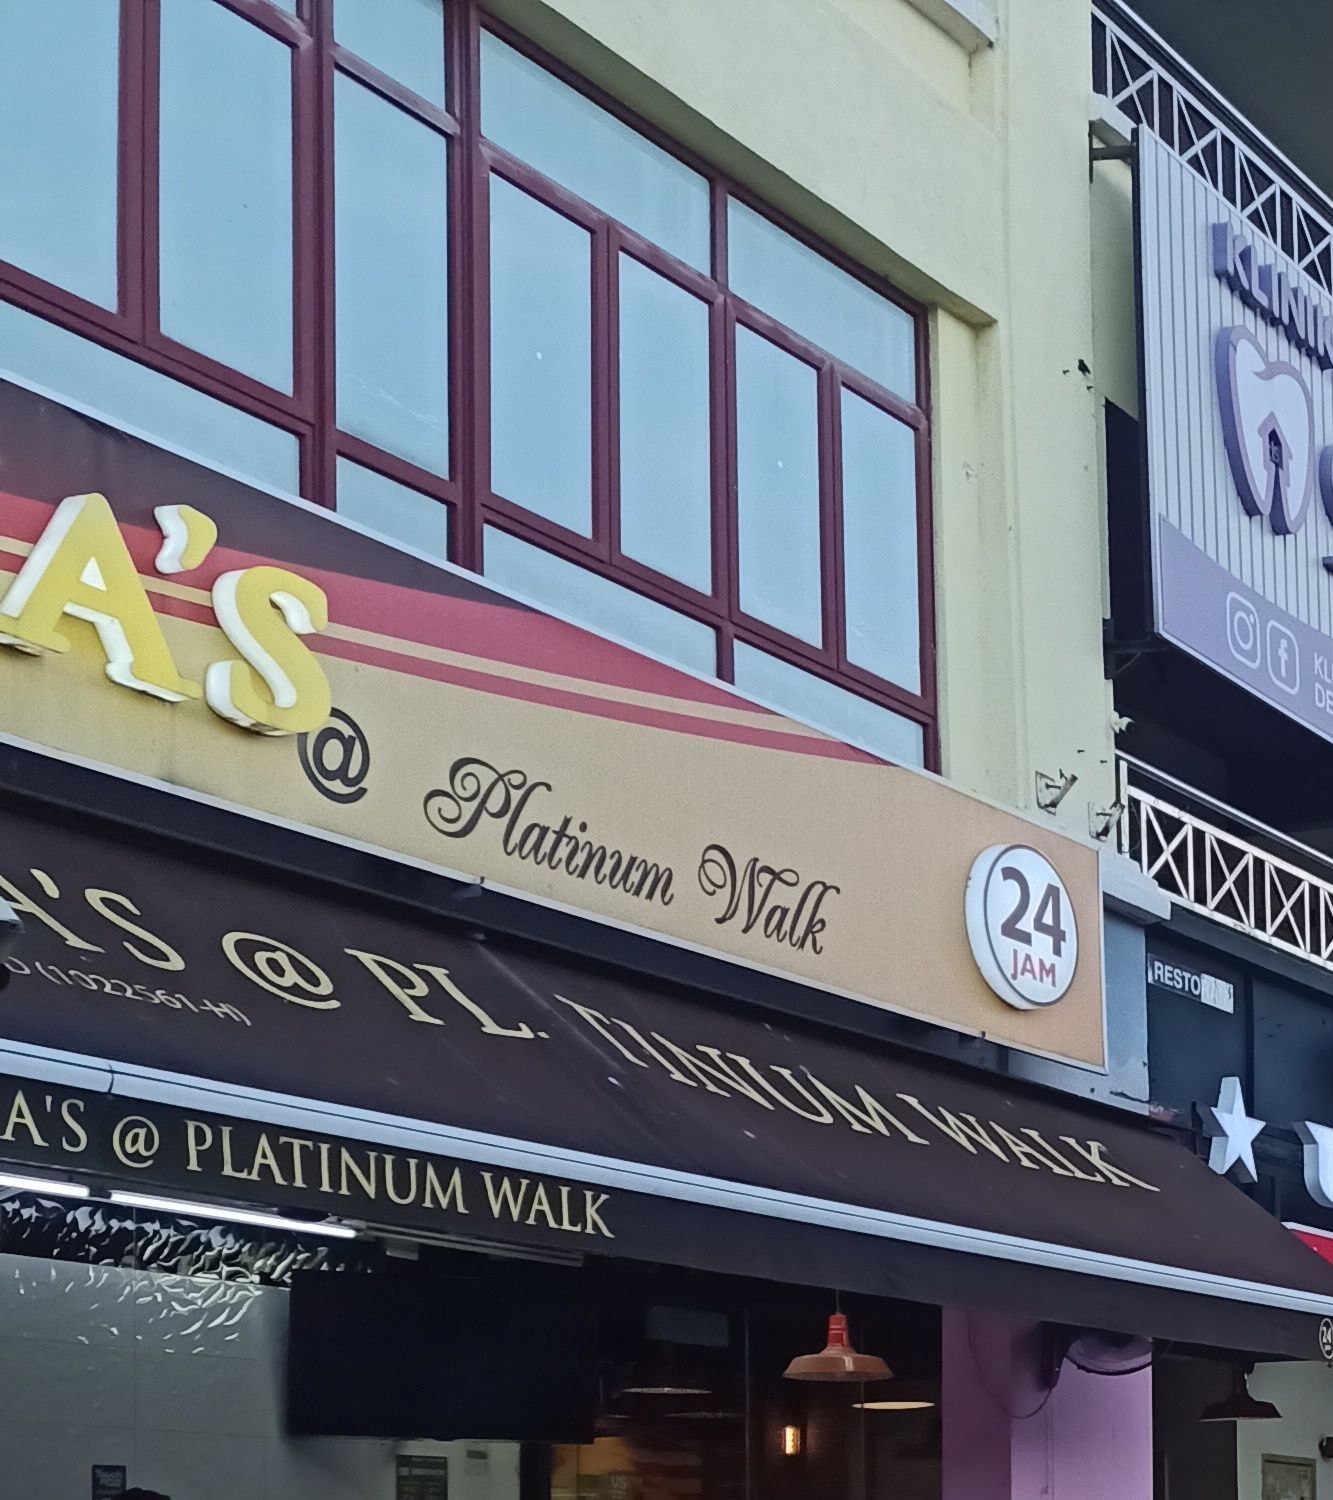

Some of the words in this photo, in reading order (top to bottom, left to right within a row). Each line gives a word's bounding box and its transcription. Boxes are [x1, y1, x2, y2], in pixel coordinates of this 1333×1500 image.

[299, 706, 369, 804] @
[423, 757, 674, 907] Platinum
[699, 844, 841, 954] Walk
[999, 866, 1068, 957] 24
[1010, 947, 1058, 988] JAM
[222, 931, 341, 1010] @
[896, 1092, 1160, 1193] WALK
[0, 1088, 88, 1153] A'S
[112, 1116, 161, 1168] @
[185, 1120, 470, 1215] PLATINUM
[479, 1171, 616, 1239] WALK
